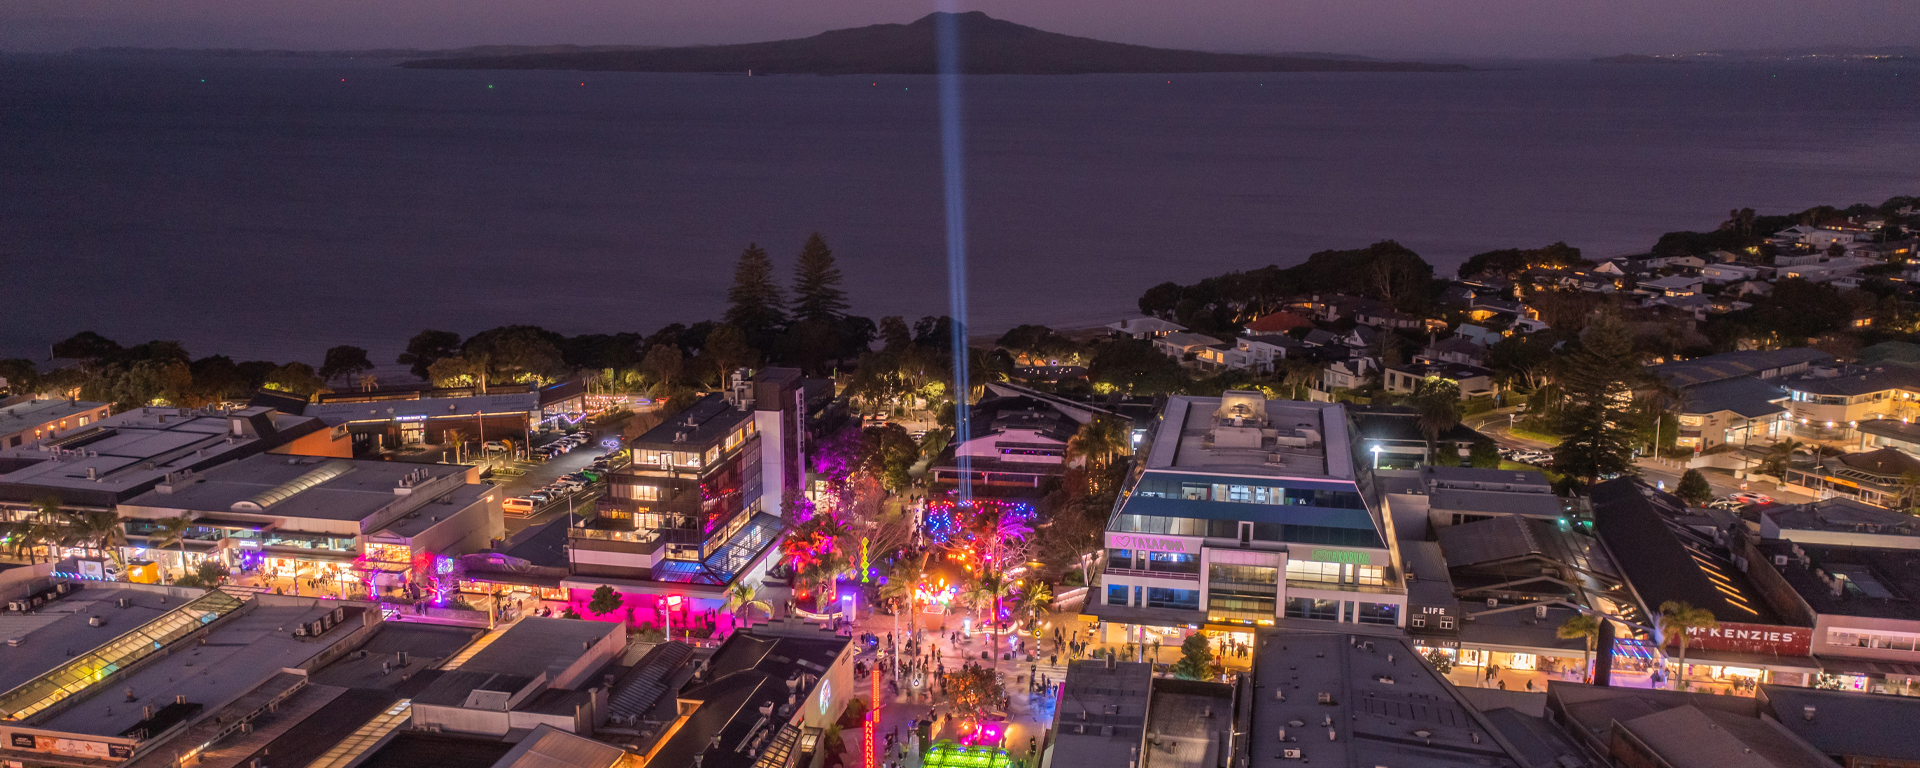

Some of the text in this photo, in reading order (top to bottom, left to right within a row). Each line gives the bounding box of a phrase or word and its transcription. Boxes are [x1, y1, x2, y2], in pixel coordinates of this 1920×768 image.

[1131, 537, 1185, 552] TAKAPUNA
[1327, 550, 1370, 564] TAKAPUNA
[1423, 607, 1445, 615] LIFE
